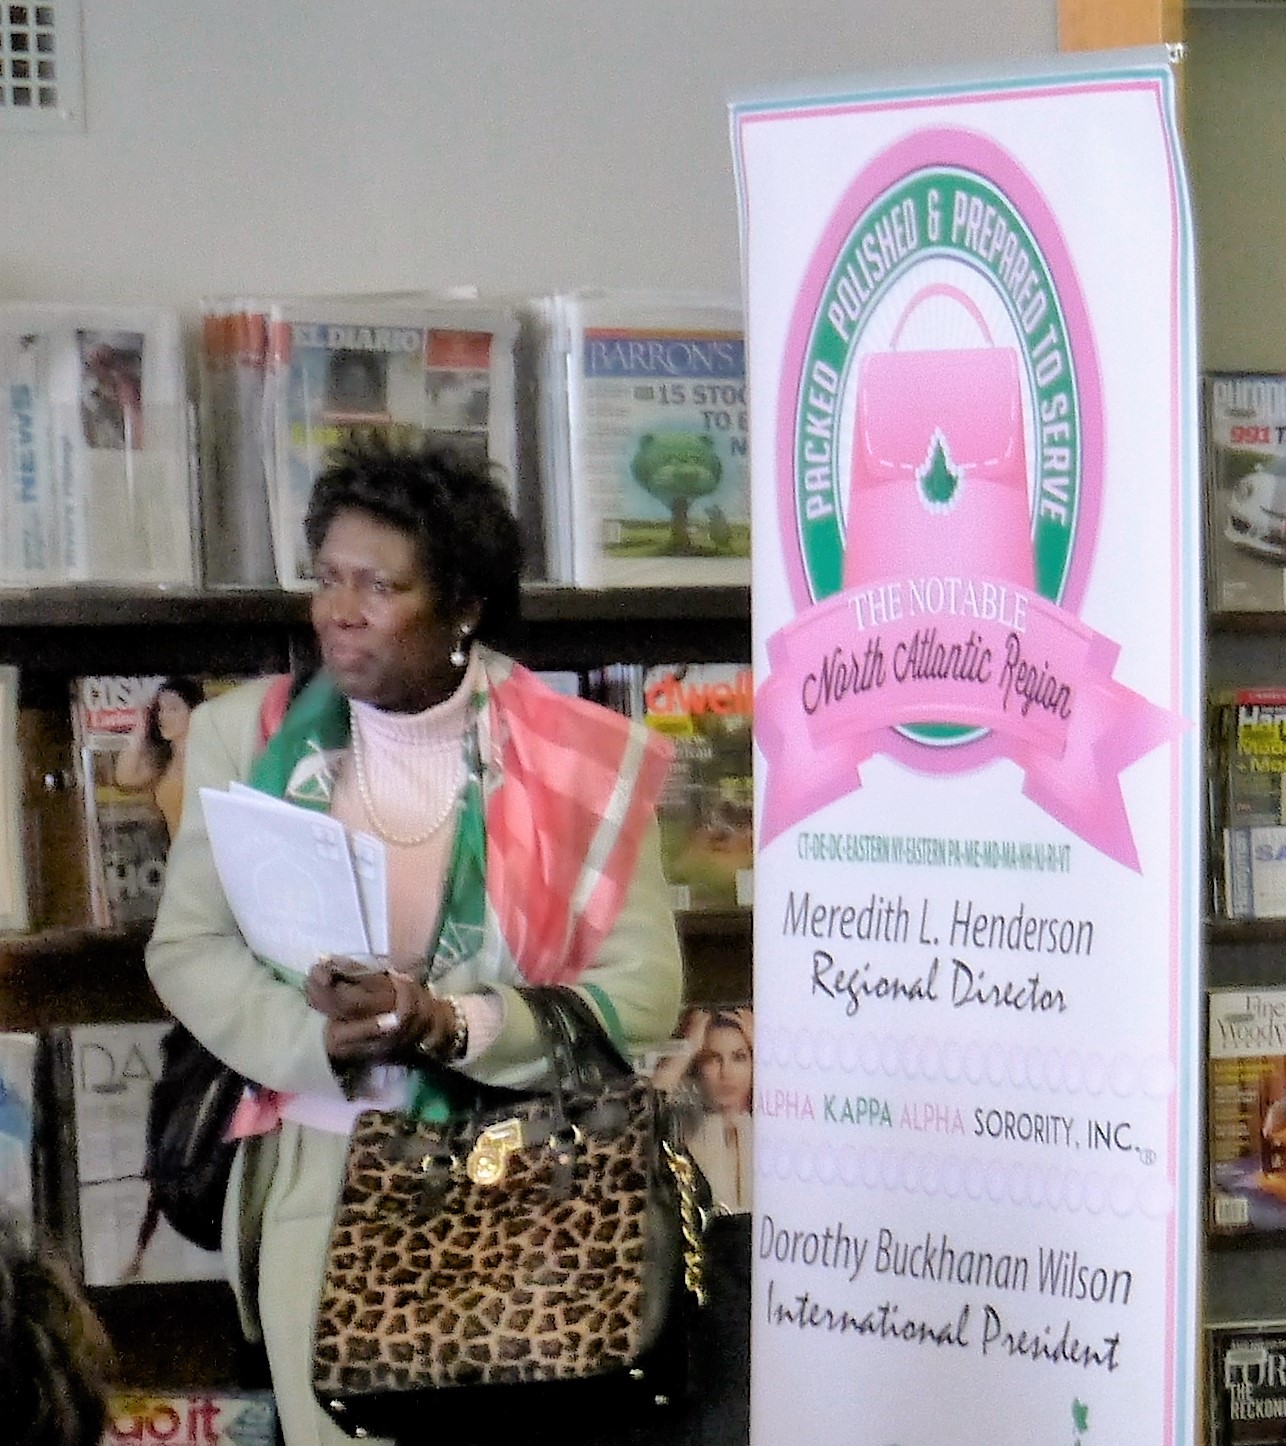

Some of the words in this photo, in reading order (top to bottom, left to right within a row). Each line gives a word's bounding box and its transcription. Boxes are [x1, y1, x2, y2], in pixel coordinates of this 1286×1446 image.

[927, 188, 940, 242] &
[826, 197, 918, 343] POLISHED
[952, 190, 1047, 338] PREPARED
[658, 384, 686, 406] 15
[1032, 322, 1064, 390] TO
[805, 360, 838, 522] PACKED
[1040, 393, 1068, 526] SERVE
[848, 588, 903, 632] THE
[908, 574, 1030, 635] NOTABLE
[802, 634, 886, 716] North
[893, 625, 992, 686] Atlantic
[998, 630, 1074, 723] Region
[782, 890, 910, 945] Meredith
[918, 897, 939, 946] L.
[948, 900, 1095, 956] Henderson
[810, 949, 938, 1018] Regional
[951, 957, 1068, 1014] Director
[755, 1089, 815, 1122] ALPHA
[822, 1094, 893, 1129] KAPPA
[899, 1101, 966, 1136] ALPHA
[759, 1214, 869, 1283] Dorothy
[875, 1227, 1030, 1293] Buckhanan
[1037, 1246, 1134, 1306] Wilson
[766, 1279, 970, 1348] International
[981, 1303, 1121, 1372] President
